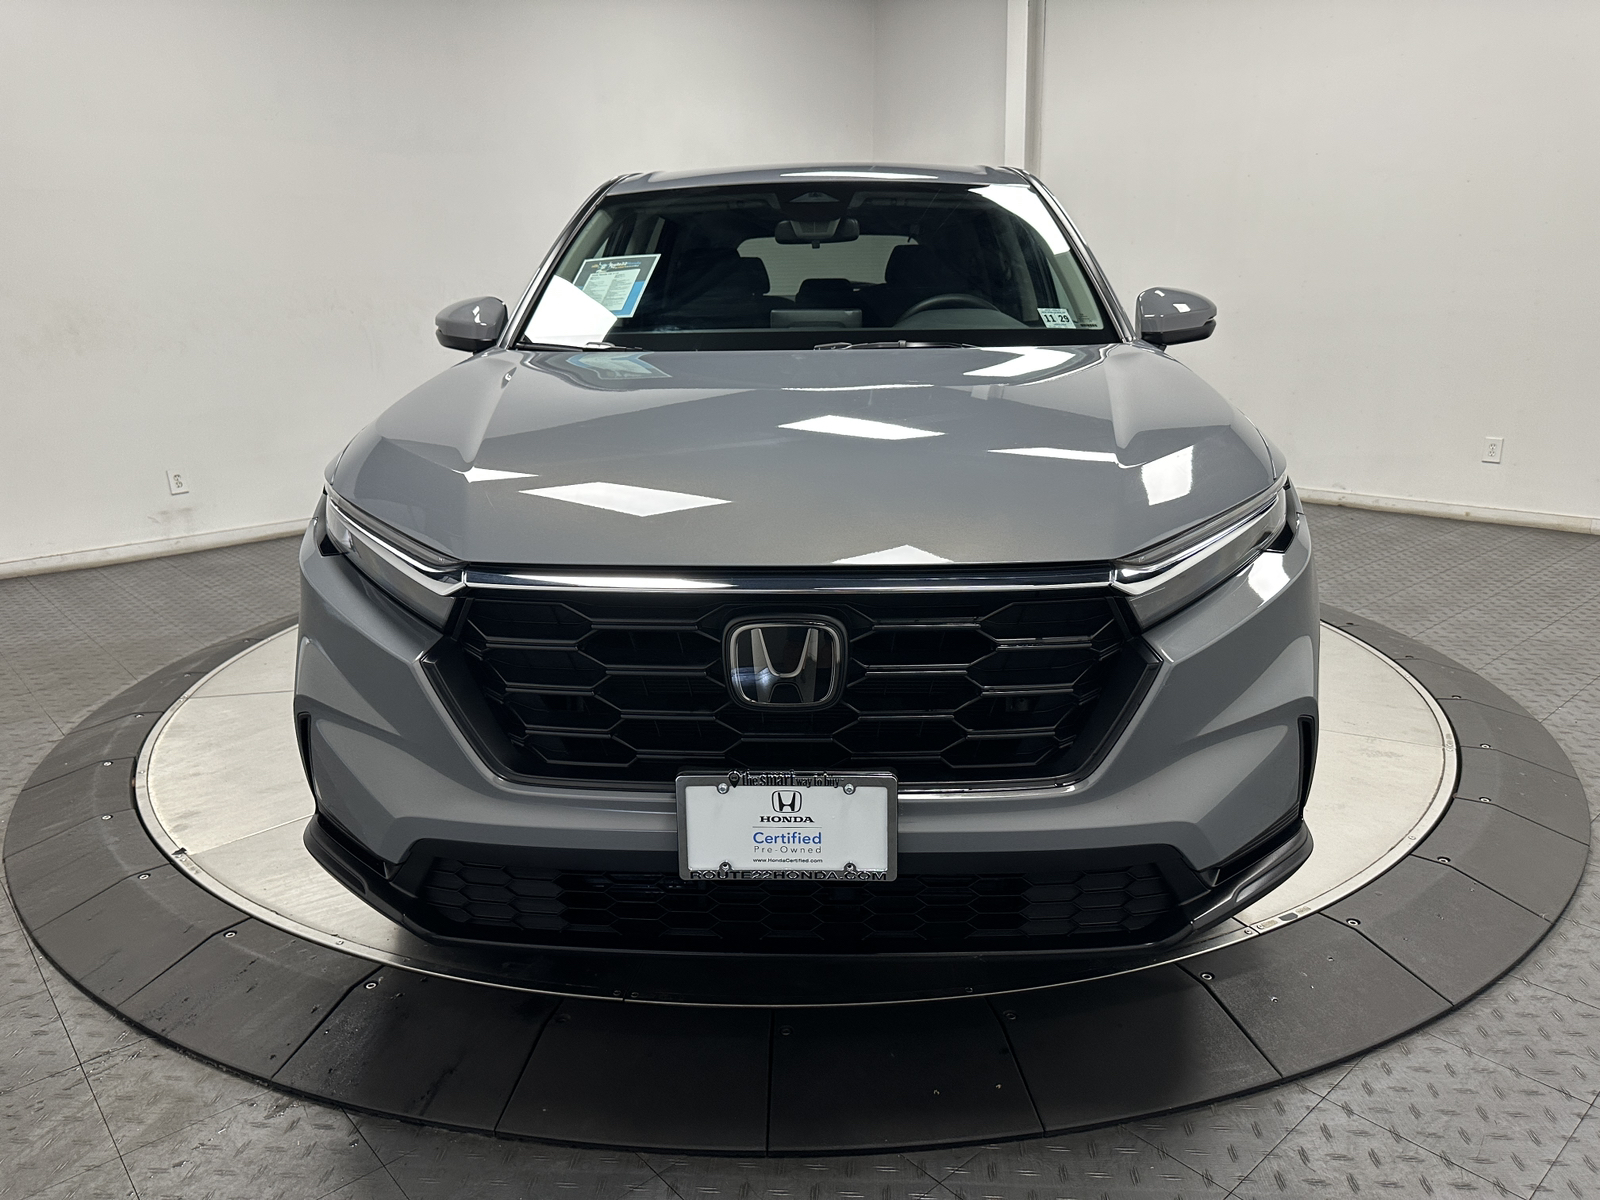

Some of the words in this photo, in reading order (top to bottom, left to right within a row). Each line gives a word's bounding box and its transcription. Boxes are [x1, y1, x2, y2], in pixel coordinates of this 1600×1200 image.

[1044, 314, 1056, 323] 11
[1058, 314, 1070, 323] 29
[741, 770, 758, 786] the
[760, 769, 795, 786] smart
[796, 777, 812, 788] way
[814, 773, 822, 786] to
[824, 771, 839, 788] buy
[753, 831, 822, 844] Certified
[754, 845, 822, 854] Pre-Owned
[690, 870, 887, 880] ROUTE22HONDA.COM
